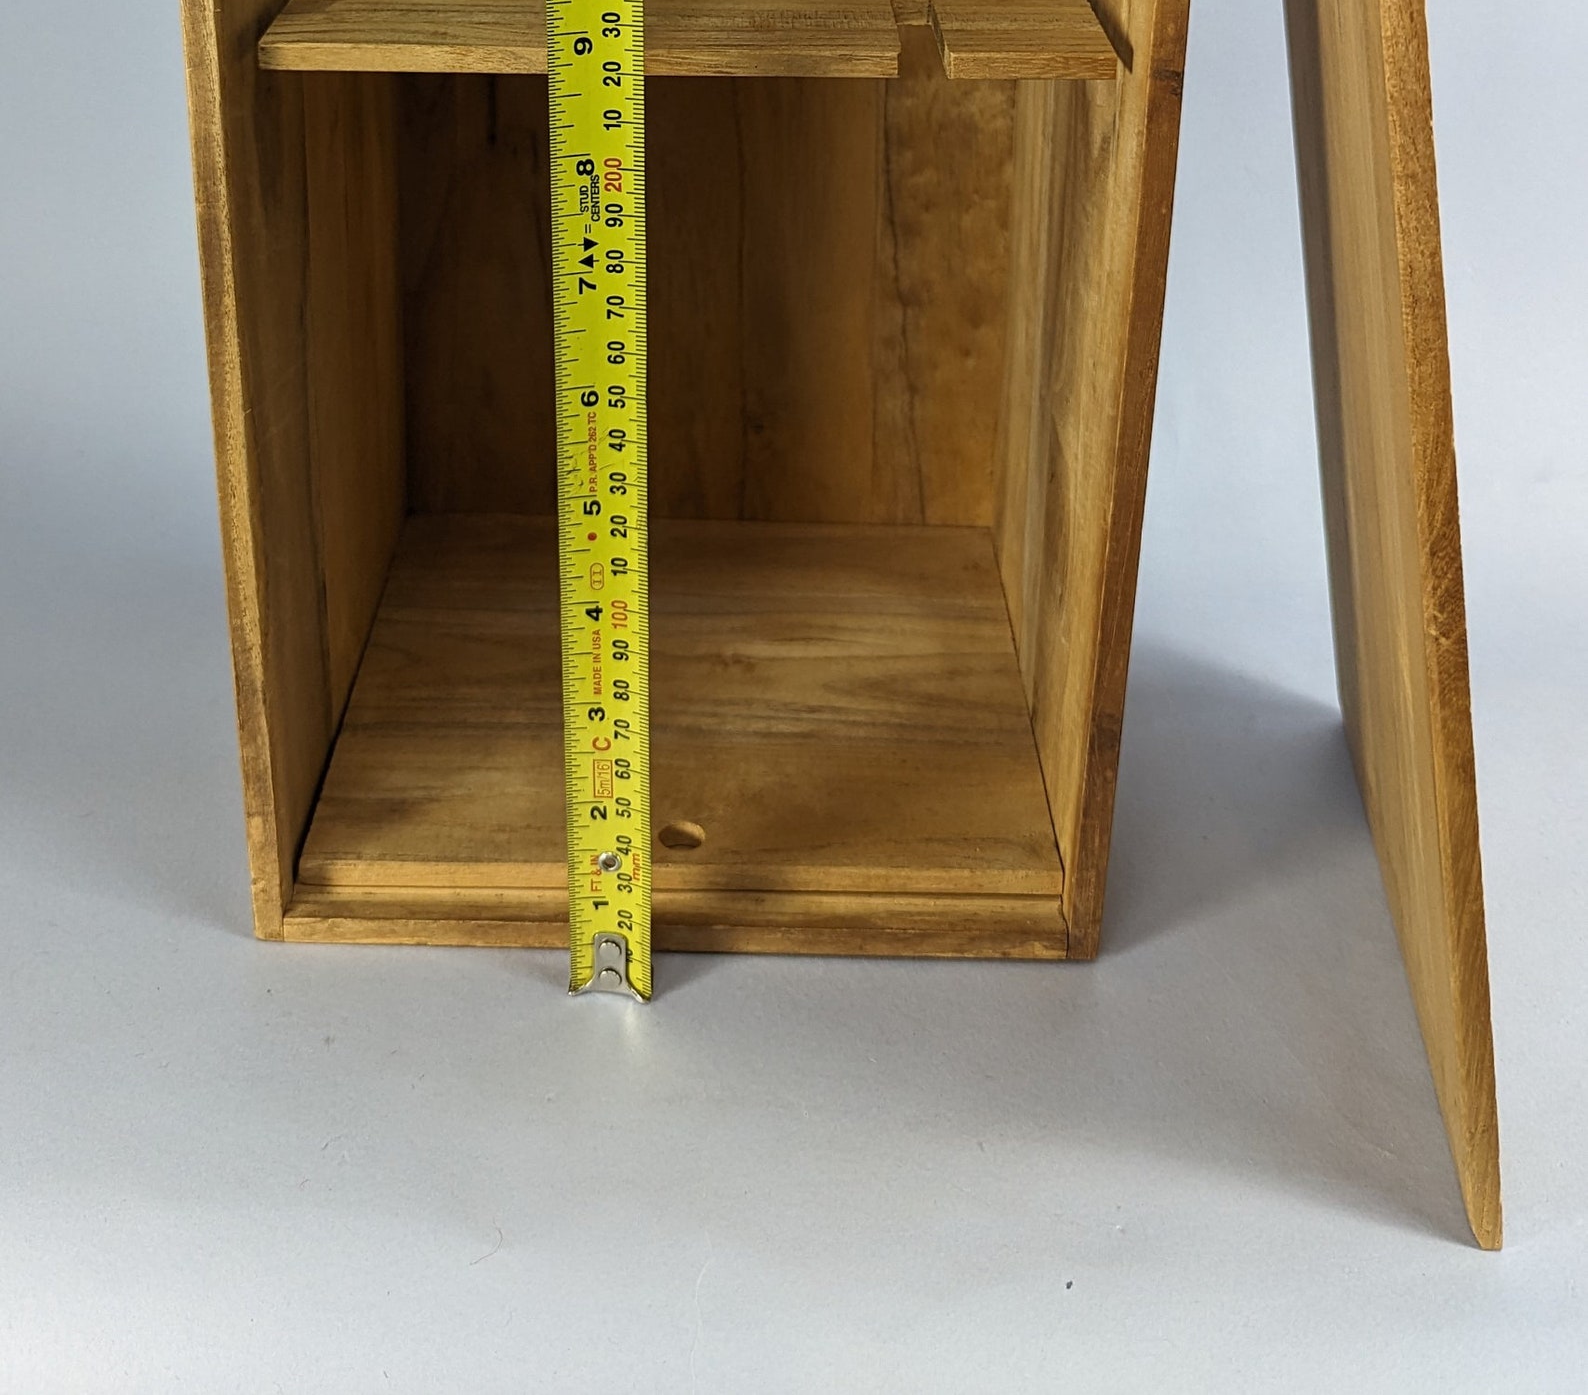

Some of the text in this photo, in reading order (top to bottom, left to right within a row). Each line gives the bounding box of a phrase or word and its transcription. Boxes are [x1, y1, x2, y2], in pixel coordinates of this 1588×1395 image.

[601, 12, 621, 38] 30
[573, 36, 593, 56] 9
[602, 61, 622, 87] 20
[603, 109, 622, 131] 10
[576, 159, 595, 176] 8
[604, 158, 622, 193] 200
[579, 185, 589, 213] STUD
[590, 174, 600, 222] CENTERS
[605, 203, 624, 228] 90
[606, 250, 624, 274] 80
[579, 277, 597, 295] 7
[606, 295, 625, 320] 70
[607, 341, 625, 365] 60
[581, 390, 599, 407] 6
[608, 385, 626, 409] 50
[587, 411, 597, 424] TC
[608, 429, 626, 452] 40
[609, 472, 627, 495] 30
[583, 500, 601, 516] 5
[610, 515, 628, 539] 20
[611, 557, 628, 576] 10
[585, 605, 603, 621] 4
[611, 600, 628, 629] 100
[612, 639, 629, 661] 90
[592, 629, 602, 695] MADE IN USA
[613, 679, 630, 702] 80
[588, 706, 606, 722] 3
[614, 719, 630, 740] 70
[592, 736, 611, 751] C
[614, 759, 631, 780] 60
[590, 805, 607, 820] 2
[615, 797, 631, 819] 50
[616, 835, 632, 856] 40
[632, 853, 641, 881] mm
[591, 879, 602, 892] FT
[617, 873, 633, 894] 30
[592, 900, 609, 911] 1
[618, 910, 633, 931] 20
